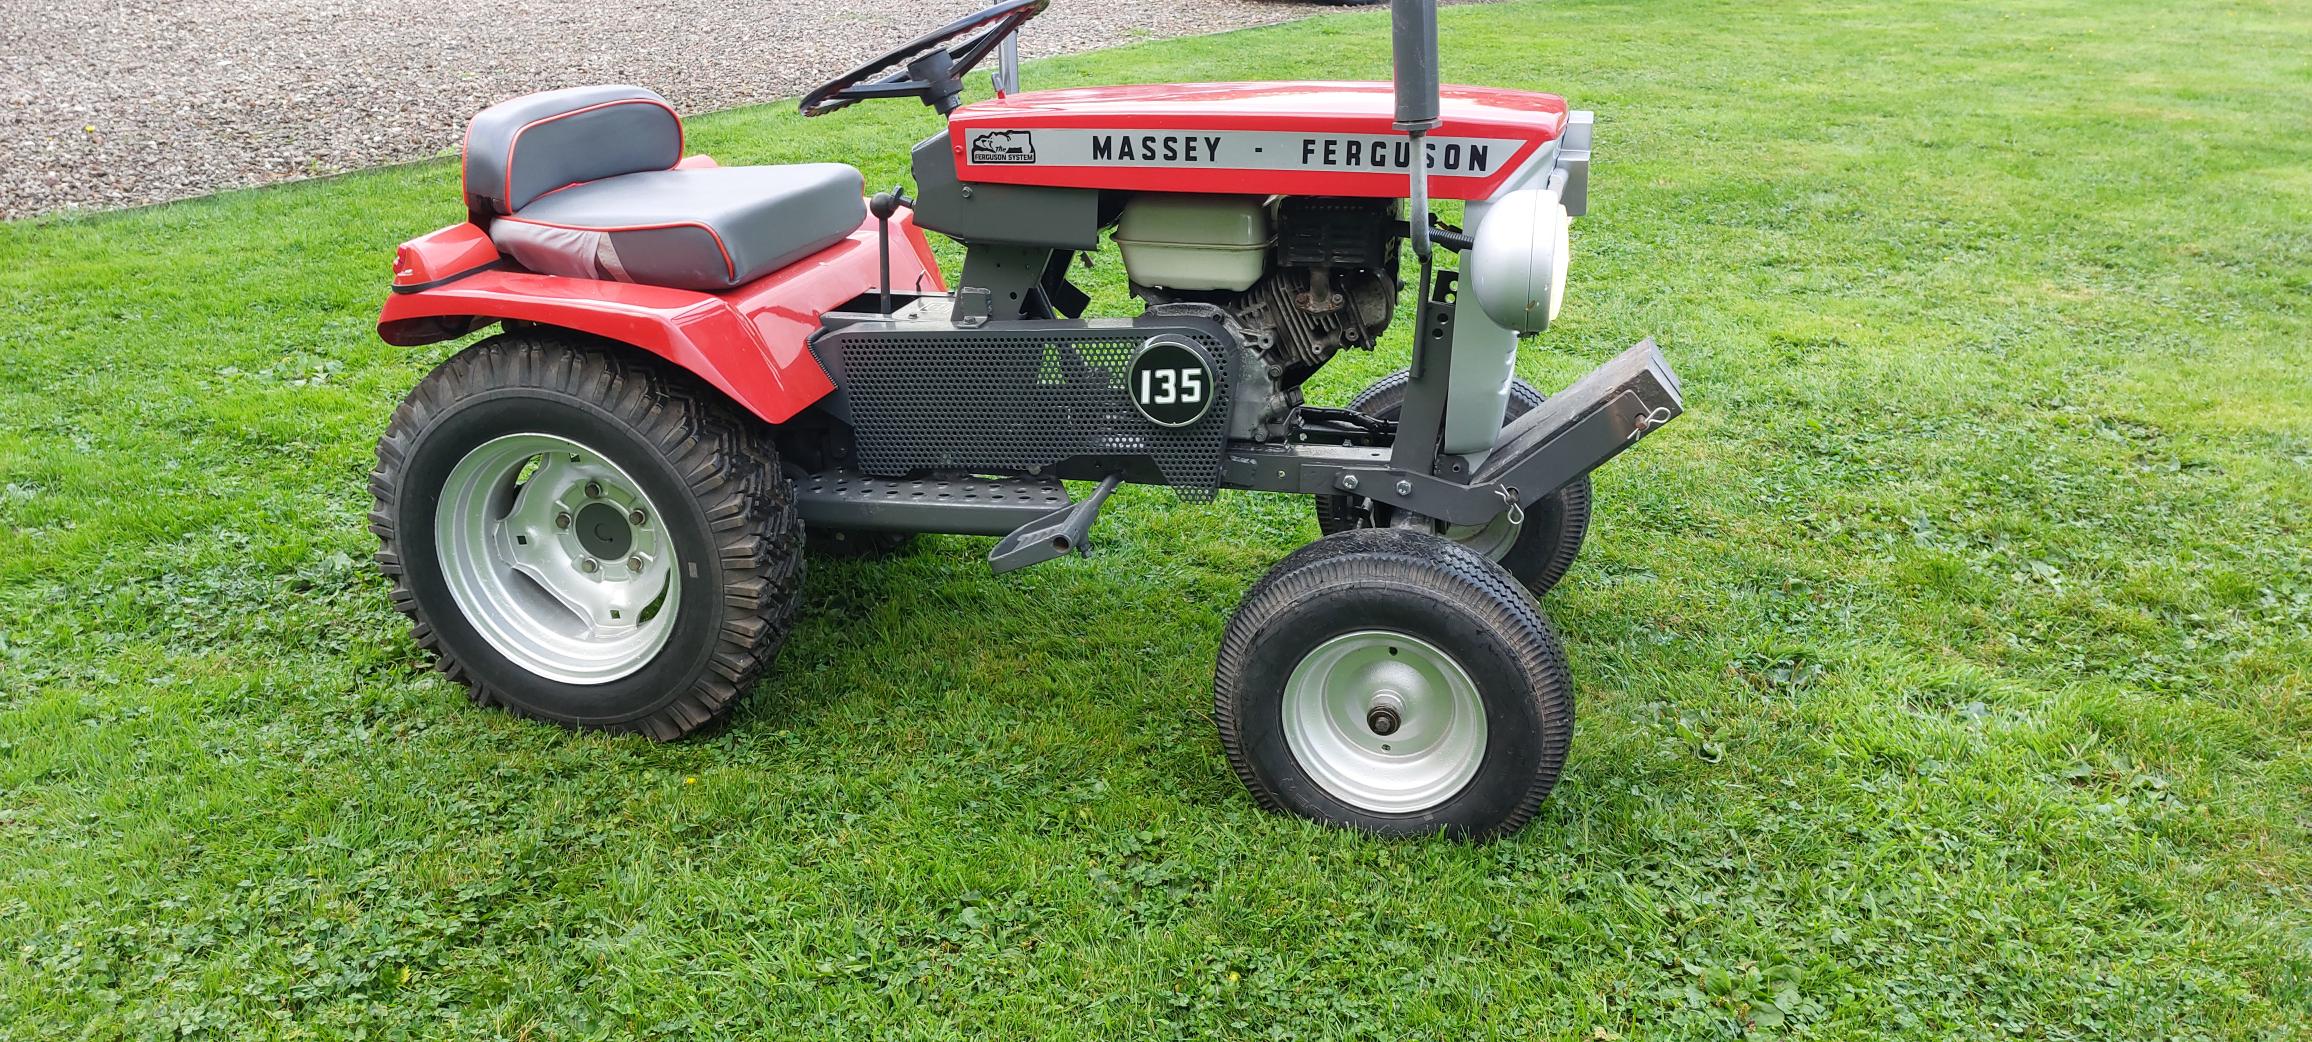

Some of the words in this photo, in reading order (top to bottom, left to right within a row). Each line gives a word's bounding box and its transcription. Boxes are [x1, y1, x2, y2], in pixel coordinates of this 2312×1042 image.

[975, 153, 1007, 161] FERGUSON
[1092, 135, 1222, 162] MASSEY
[1302, 139, 1488, 172] FERGUSON
[1140, 367, 1202, 405] 135
